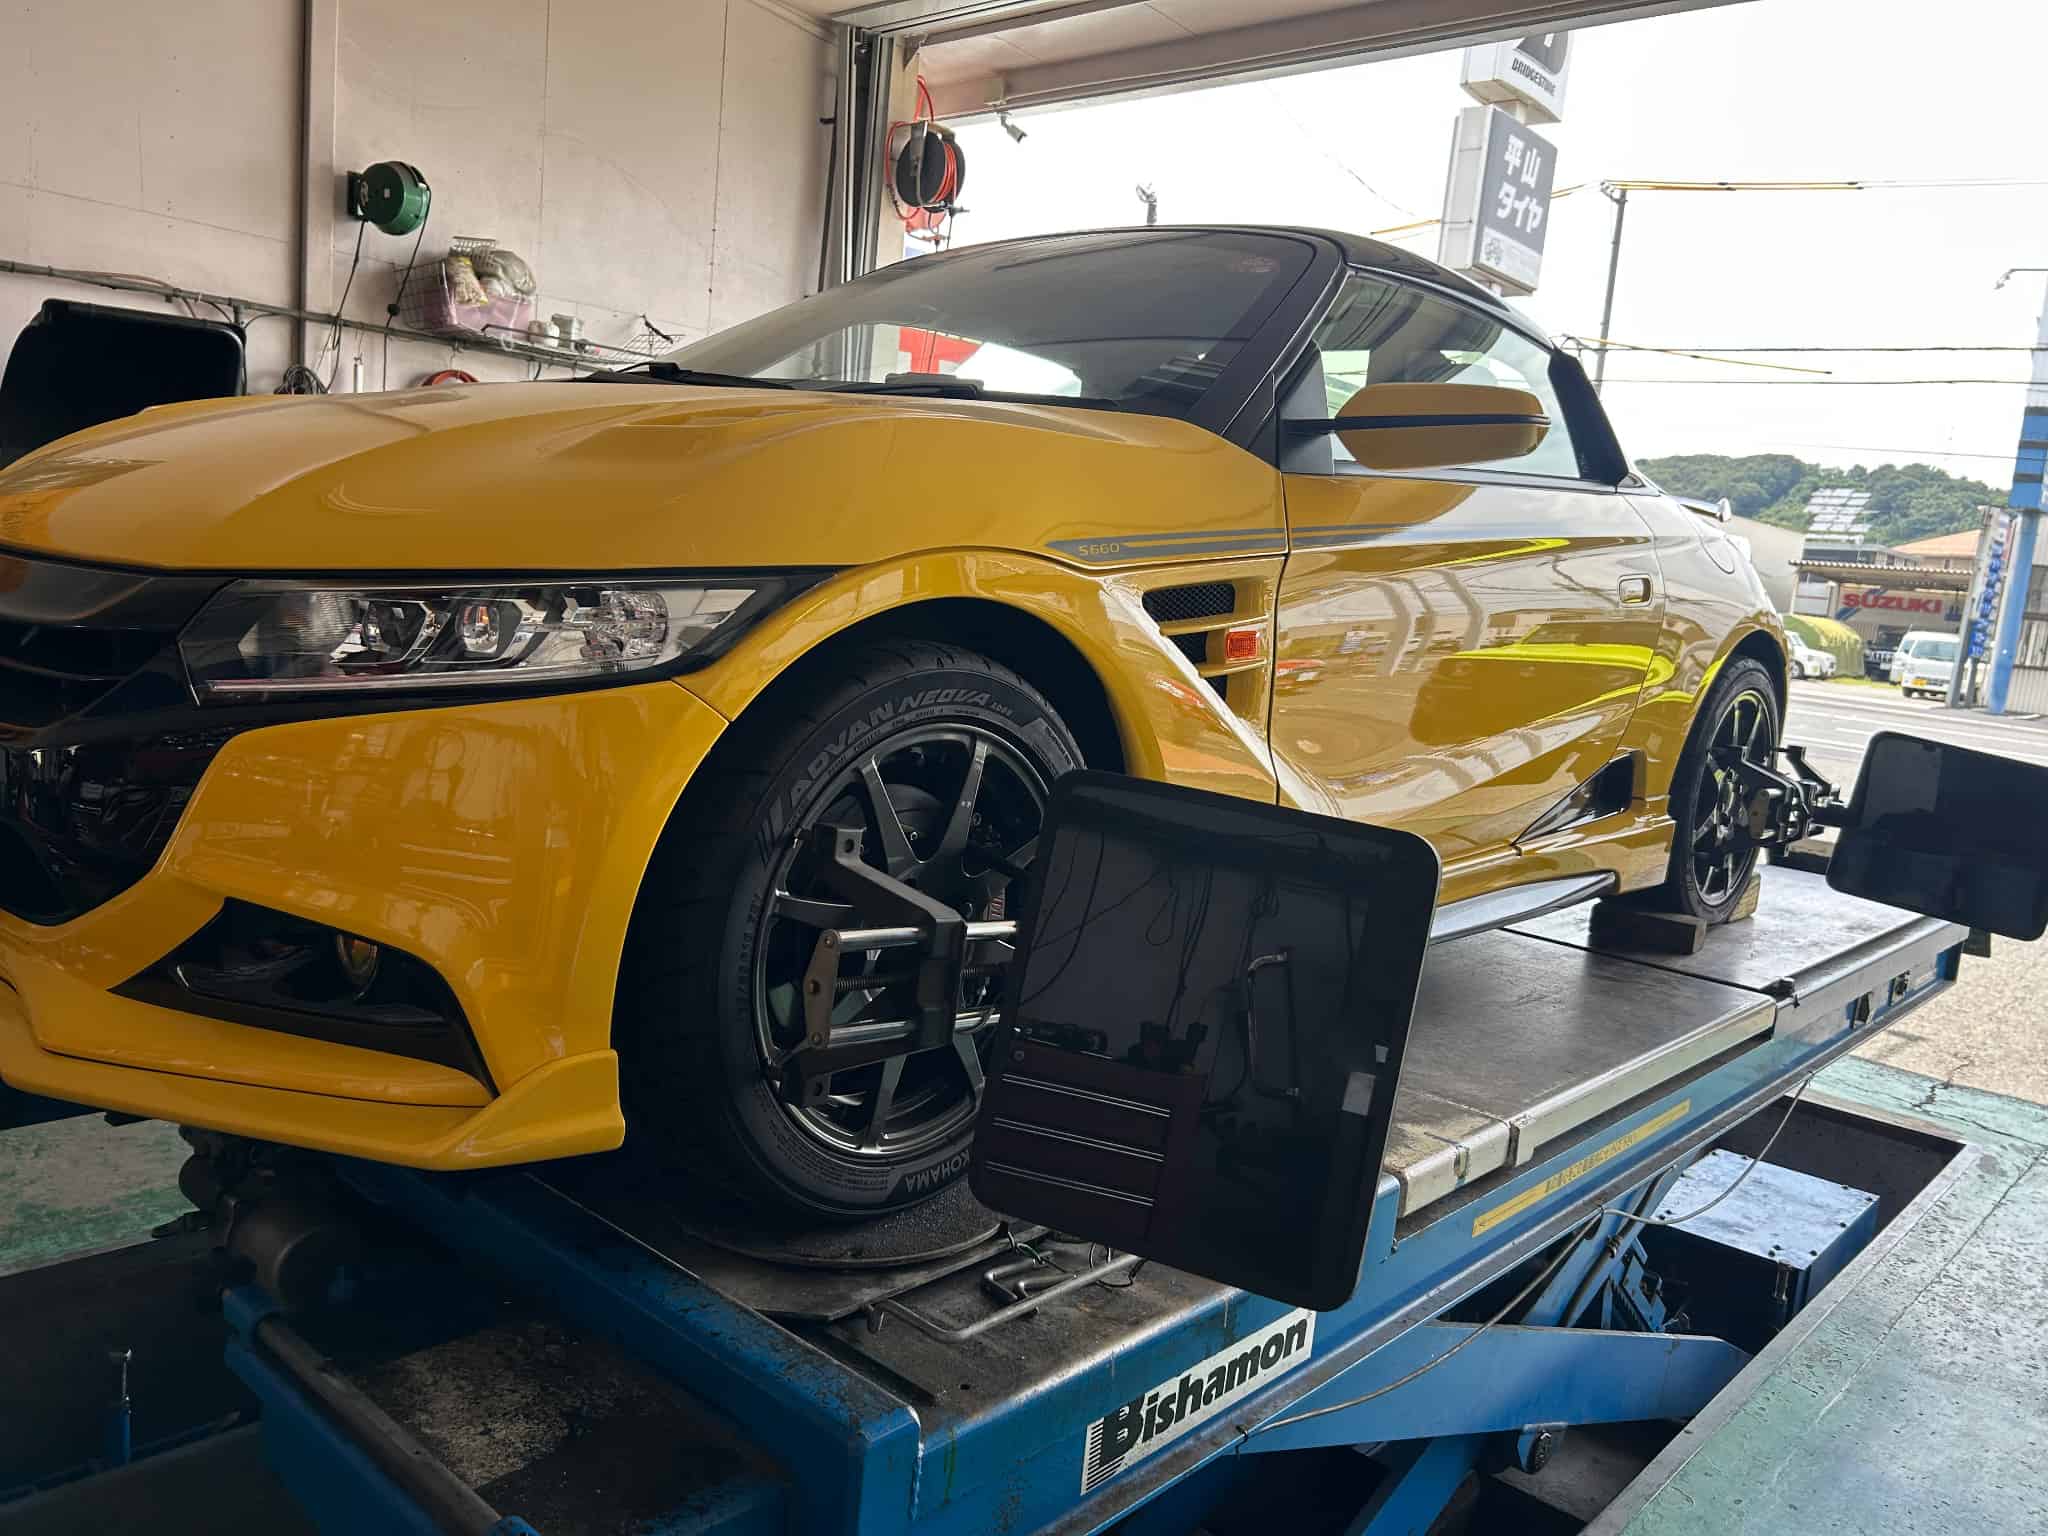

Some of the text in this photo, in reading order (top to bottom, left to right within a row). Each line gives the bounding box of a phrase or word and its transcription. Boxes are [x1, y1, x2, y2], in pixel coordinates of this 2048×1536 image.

[1503, 133, 1542, 189] 平山
[1495, 181, 1544, 234] タイヤ
[1079, 543, 1120, 557] S660
[1841, 593, 1944, 614] SUZUKI
[791, 700, 898, 808] ADVAN
[898, 688, 992, 713] NEOVA
[904, 1148, 970, 1194] KOHAMA
[1092, 1318, 1308, 1475] Bishamon
